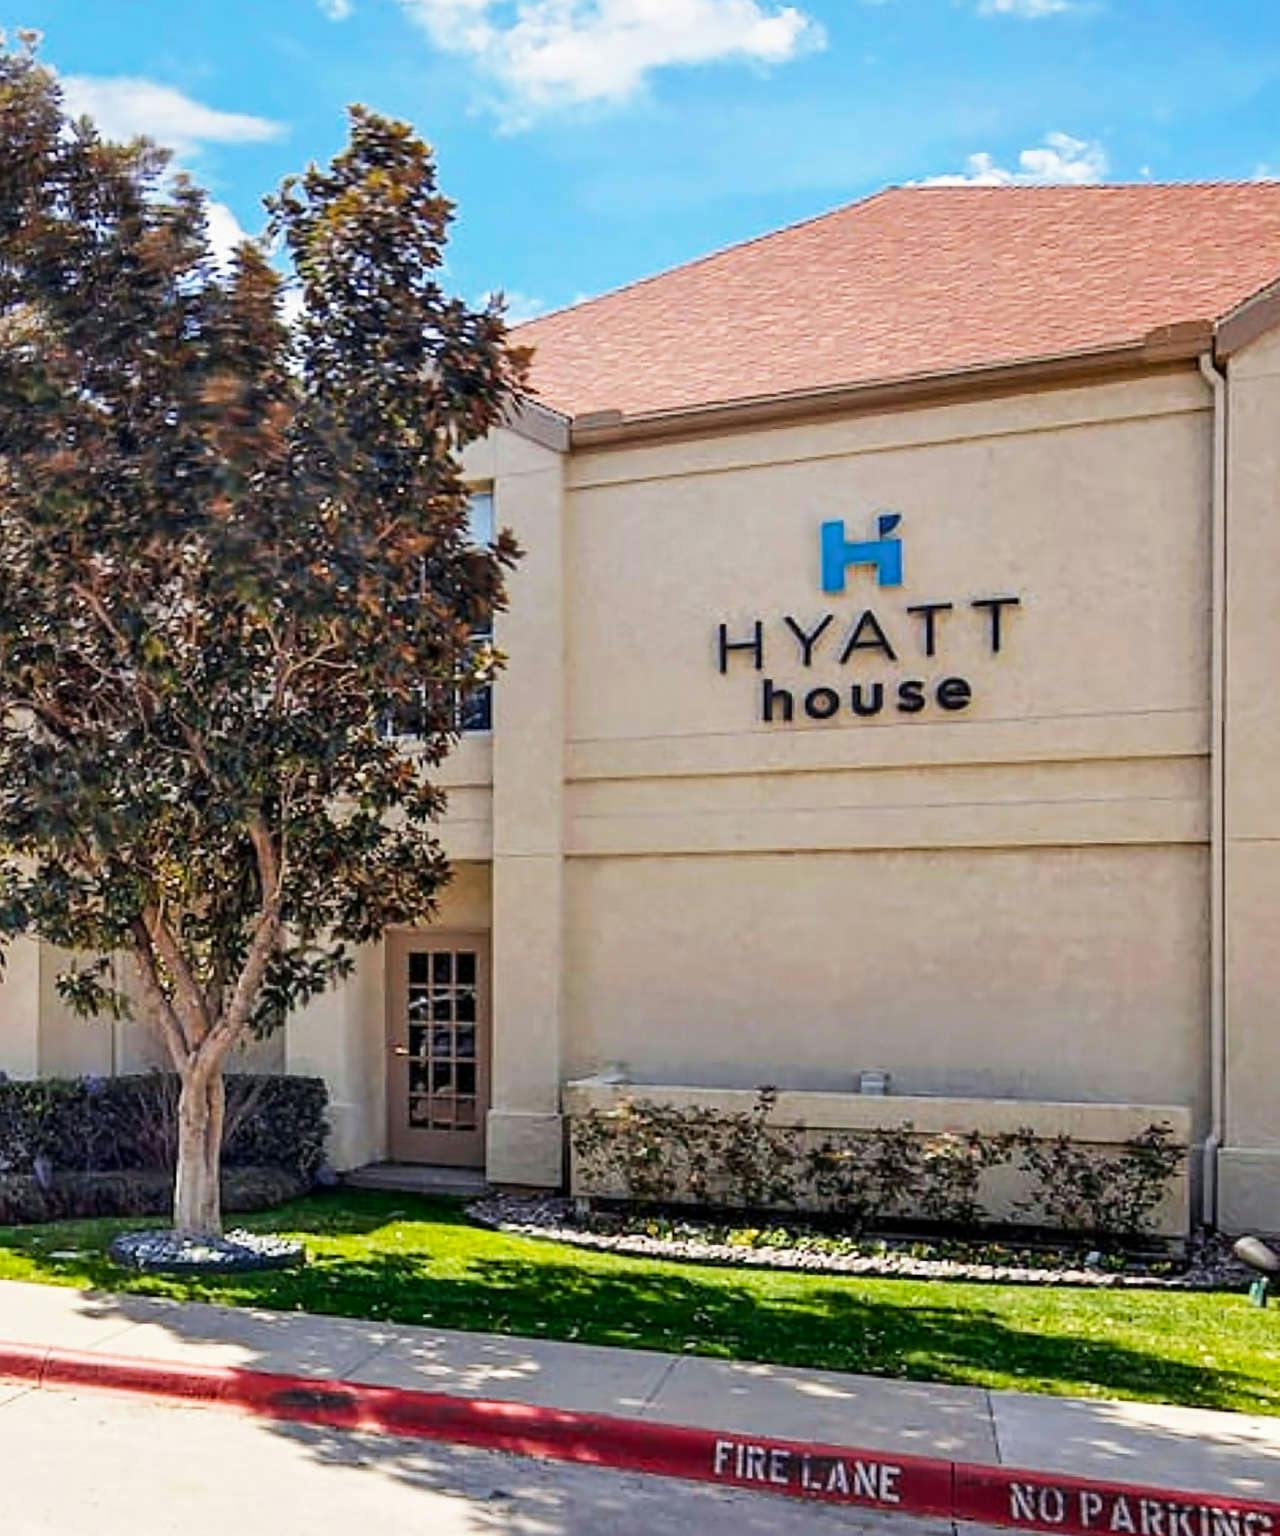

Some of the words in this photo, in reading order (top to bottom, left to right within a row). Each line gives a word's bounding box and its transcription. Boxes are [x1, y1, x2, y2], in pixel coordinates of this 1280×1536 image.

[719, 598, 1019, 674] HYATT
[762, 677, 972, 721] house
[714, 1439, 790, 1483] FIRE
[800, 1453, 901, 1502] LANE
[1010, 1482, 1064, 1522] NO
[1080, 1491, 1273, 1536] PARKING
